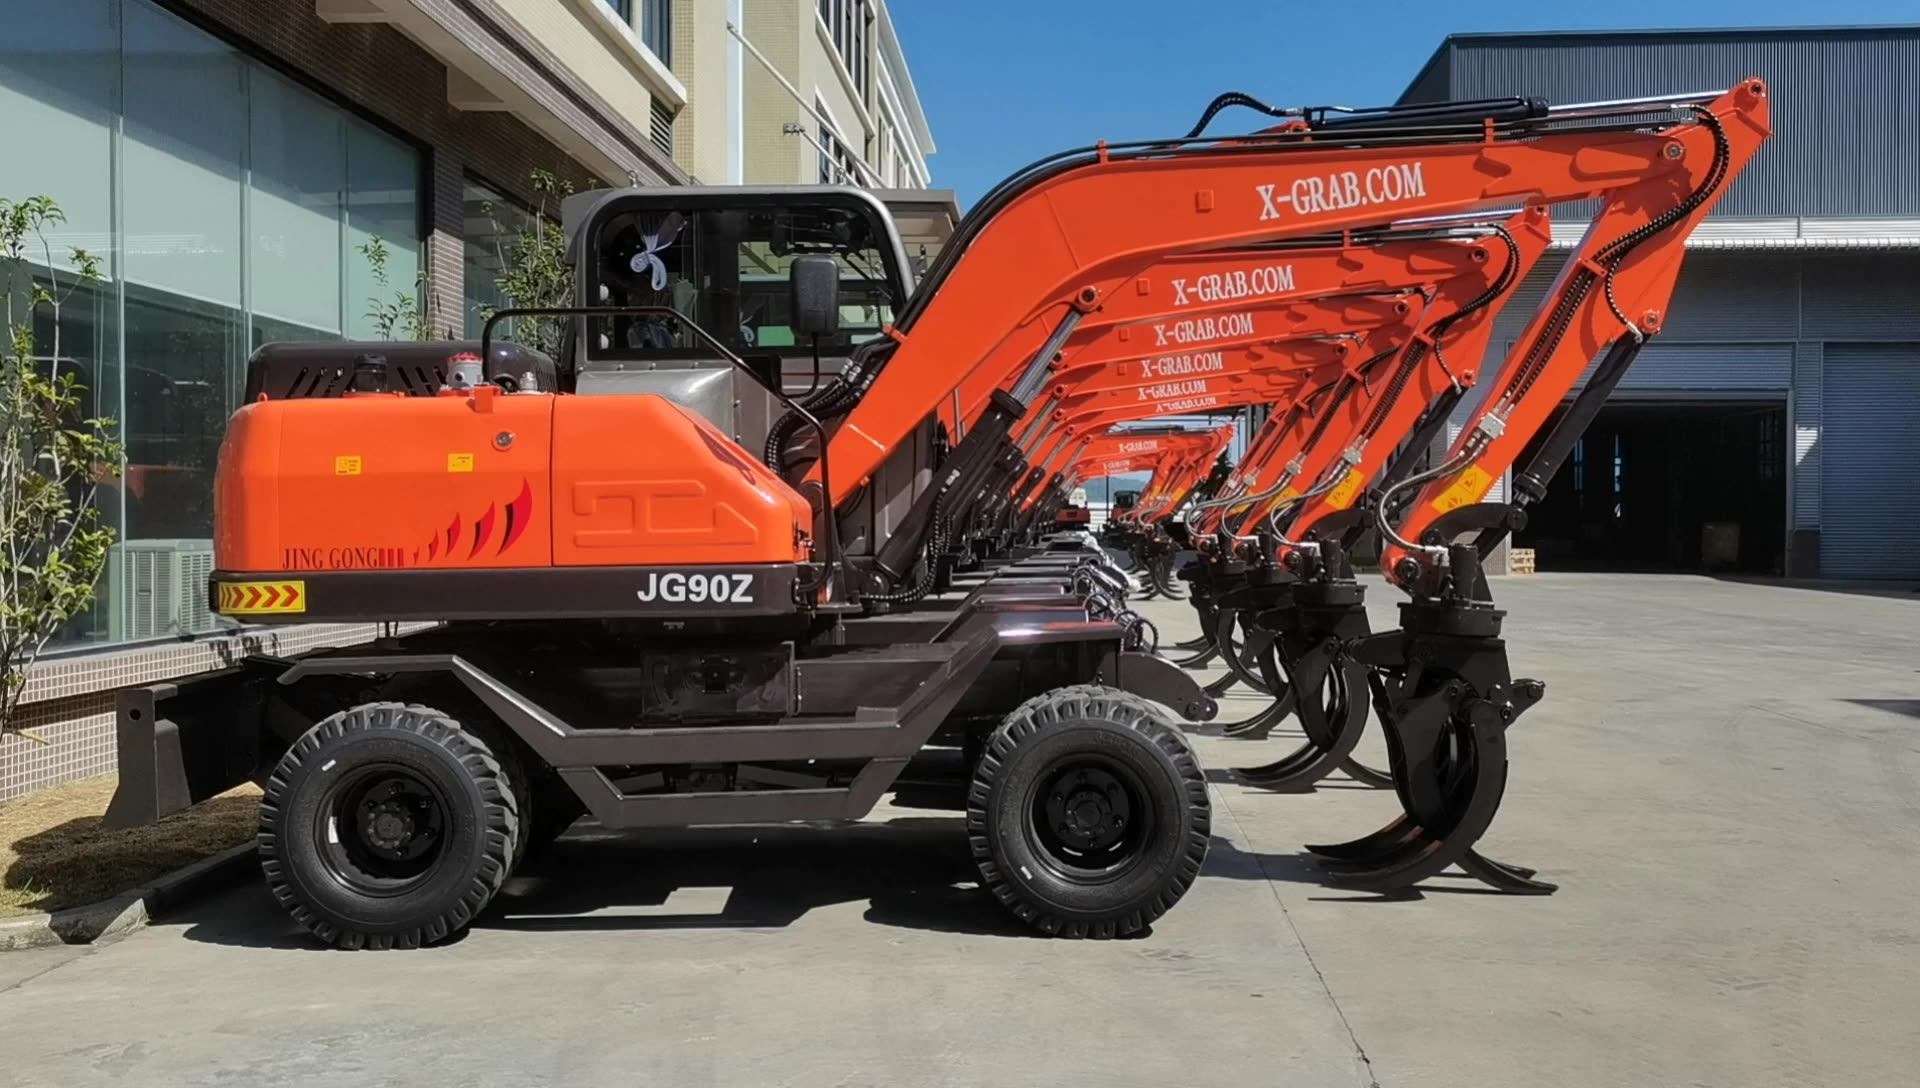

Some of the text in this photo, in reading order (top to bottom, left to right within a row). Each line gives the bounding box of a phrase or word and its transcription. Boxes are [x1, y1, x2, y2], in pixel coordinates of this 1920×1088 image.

[1256, 162, 1426, 220] X-GRAB.COM
[1172, 265, 1295, 305] X-GRAB.COM
[1154, 313, 1254, 346] X-GRAB.COM
[1141, 352, 1223, 378] X-GRAB.COM
[282, 547, 377, 570] JING GONG
[637, 572, 754, 603] JG90Z
